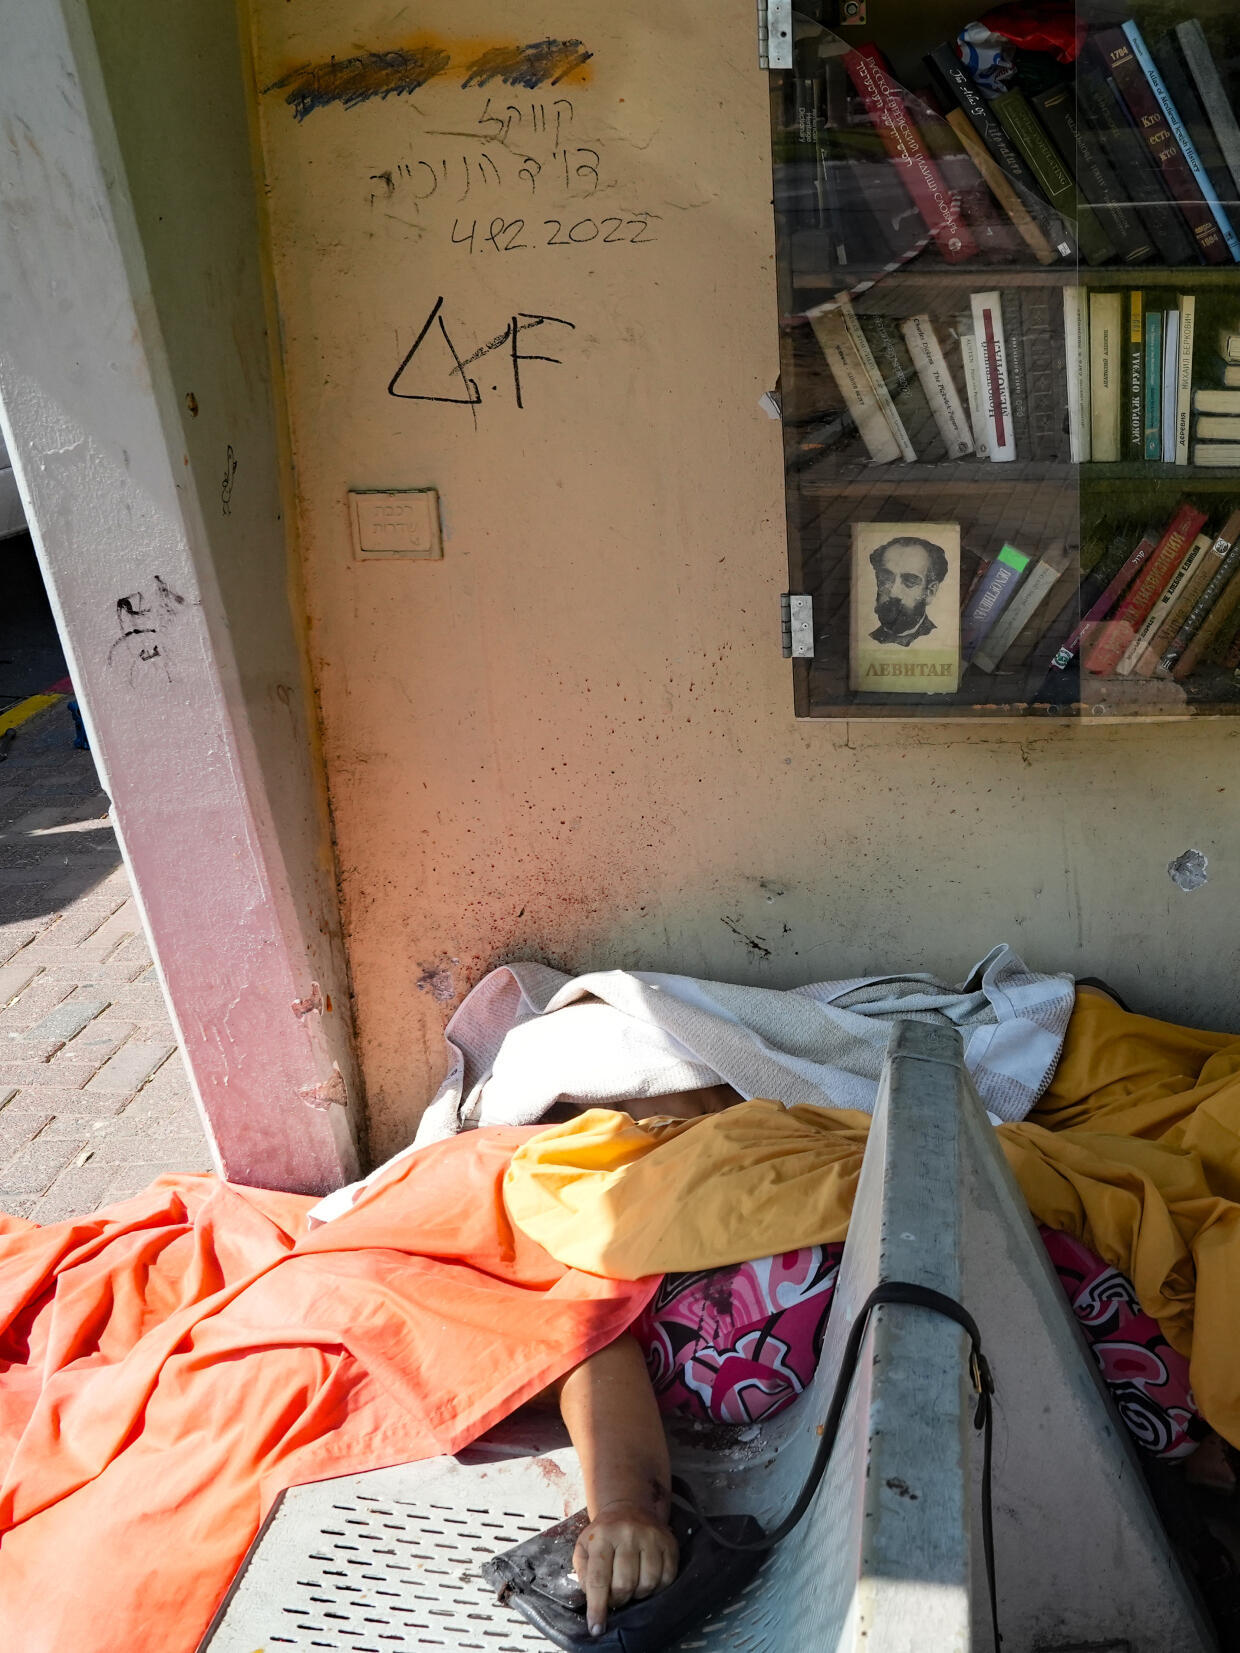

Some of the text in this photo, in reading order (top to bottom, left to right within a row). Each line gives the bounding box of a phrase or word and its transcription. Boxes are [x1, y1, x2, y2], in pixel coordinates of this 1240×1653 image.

[1147, 69, 1160, 87] Atlas
[1183, 146, 1202, 173] History
[1182, 312, 1191, 354] БЕРКОВИЧ
[1181, 358, 1189, 389] МИХАИЛ
[1130, 352, 1140, 444] ДЖОРДЖ ОРУЭЛЛ
[865, 662, 953, 677] ЛЕВИТАН
